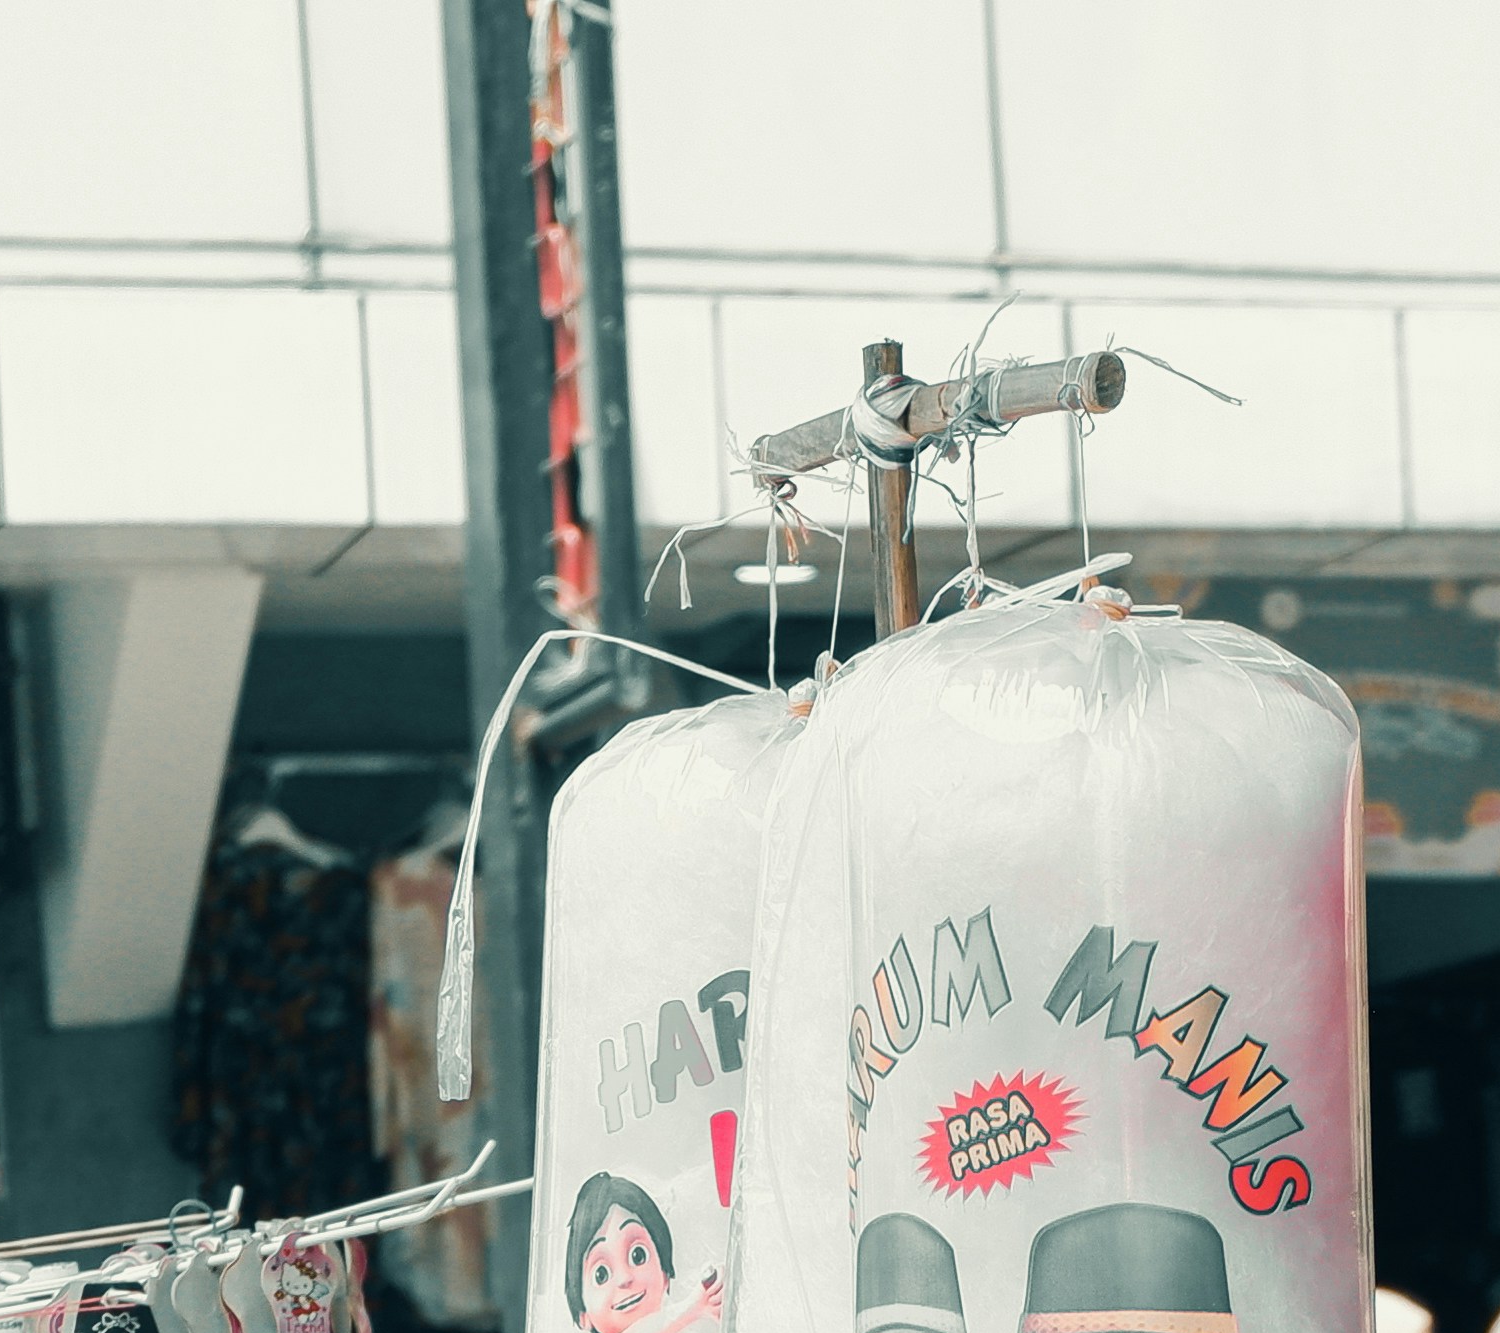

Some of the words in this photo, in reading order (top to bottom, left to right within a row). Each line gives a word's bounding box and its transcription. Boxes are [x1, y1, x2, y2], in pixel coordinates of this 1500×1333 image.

[847, 904, 1014, 1190] RUM
[1043, 924, 1312, 1216] MANIS
[946, 1090, 1034, 1148] RASA
[948, 1117, 1051, 1182] PRIMA
